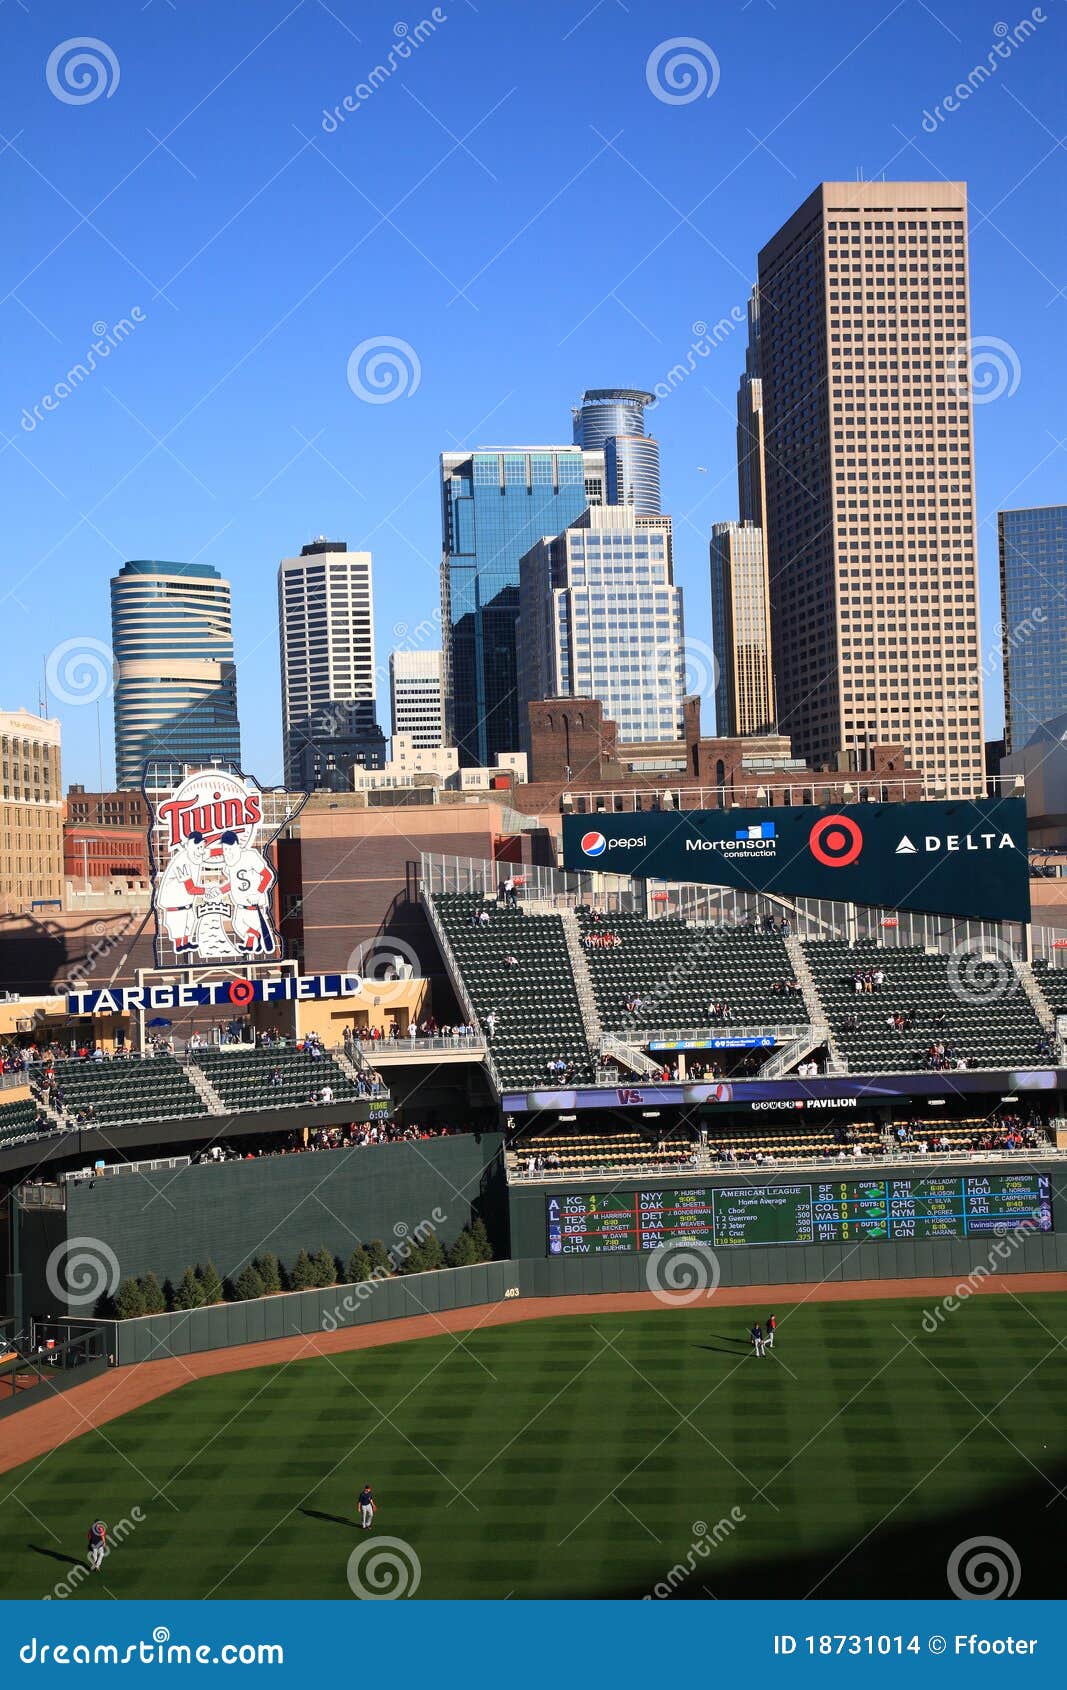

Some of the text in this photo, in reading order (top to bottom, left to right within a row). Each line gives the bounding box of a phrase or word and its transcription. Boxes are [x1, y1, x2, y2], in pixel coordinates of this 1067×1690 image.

[159, 791, 261, 847] Twins
[608, 835, 647, 850] pepsi
[685, 838, 776, 851] Mortenson
[925, 833, 1016, 852] DELTA
[724, 850, 776, 858] construction
[69, 974, 363, 1014] TARGET FIELD
[369, 1101, 388, 1111] TIME
[752, 1101, 794, 1110] POWER
[806, 1098, 857, 1109] PAVILION
[369, 1110, 389, 1120] 6:06
[893, 1181, 911, 1190] PHI
[968, 1178, 990, 1186] FLA
[720, 1187, 800, 1198] AMERICAN LEAGUE
[819, 1183, 846, 1193] SF 0
[967, 1186, 991, 1195] HOU
[641, 1192, 663, 1201] NYY
[819, 1192, 847, 1201] SD 0
[892, 1190, 913, 1198] ATL
[566, 1195, 596, 1205] KC 4
[891, 1200, 915, 1209] CHC
[969, 1197, 990, 1206] STL
[563, 1204, 597, 1214] TOR 3
[640, 1201, 664, 1209] OAK
[815, 1202, 847, 1212] COL 0
[970, 1205, 989, 1214] ARI
[641, 1211, 664, 1220] DET
[815, 1212, 839, 1220] WAS
[891, 1209, 915, 1217] NYM
[564, 1216, 586, 1224] TEX
[893, 1220, 915, 1228] LAD
[564, 1225, 587, 1233] BOS
[641, 1221, 664, 1229] LAA
[819, 1222, 849, 1232] MIL 0
[642, 1232, 664, 1240] BAL
[820, 1231, 849, 1240] PIT 0
[894, 1229, 915, 1237] CIN
[568, 1236, 583, 1244] TB
[642, 1240, 664, 1249] SEA
[563, 1244, 591, 1253] CHW
[504, 1287, 520, 1298] 403
